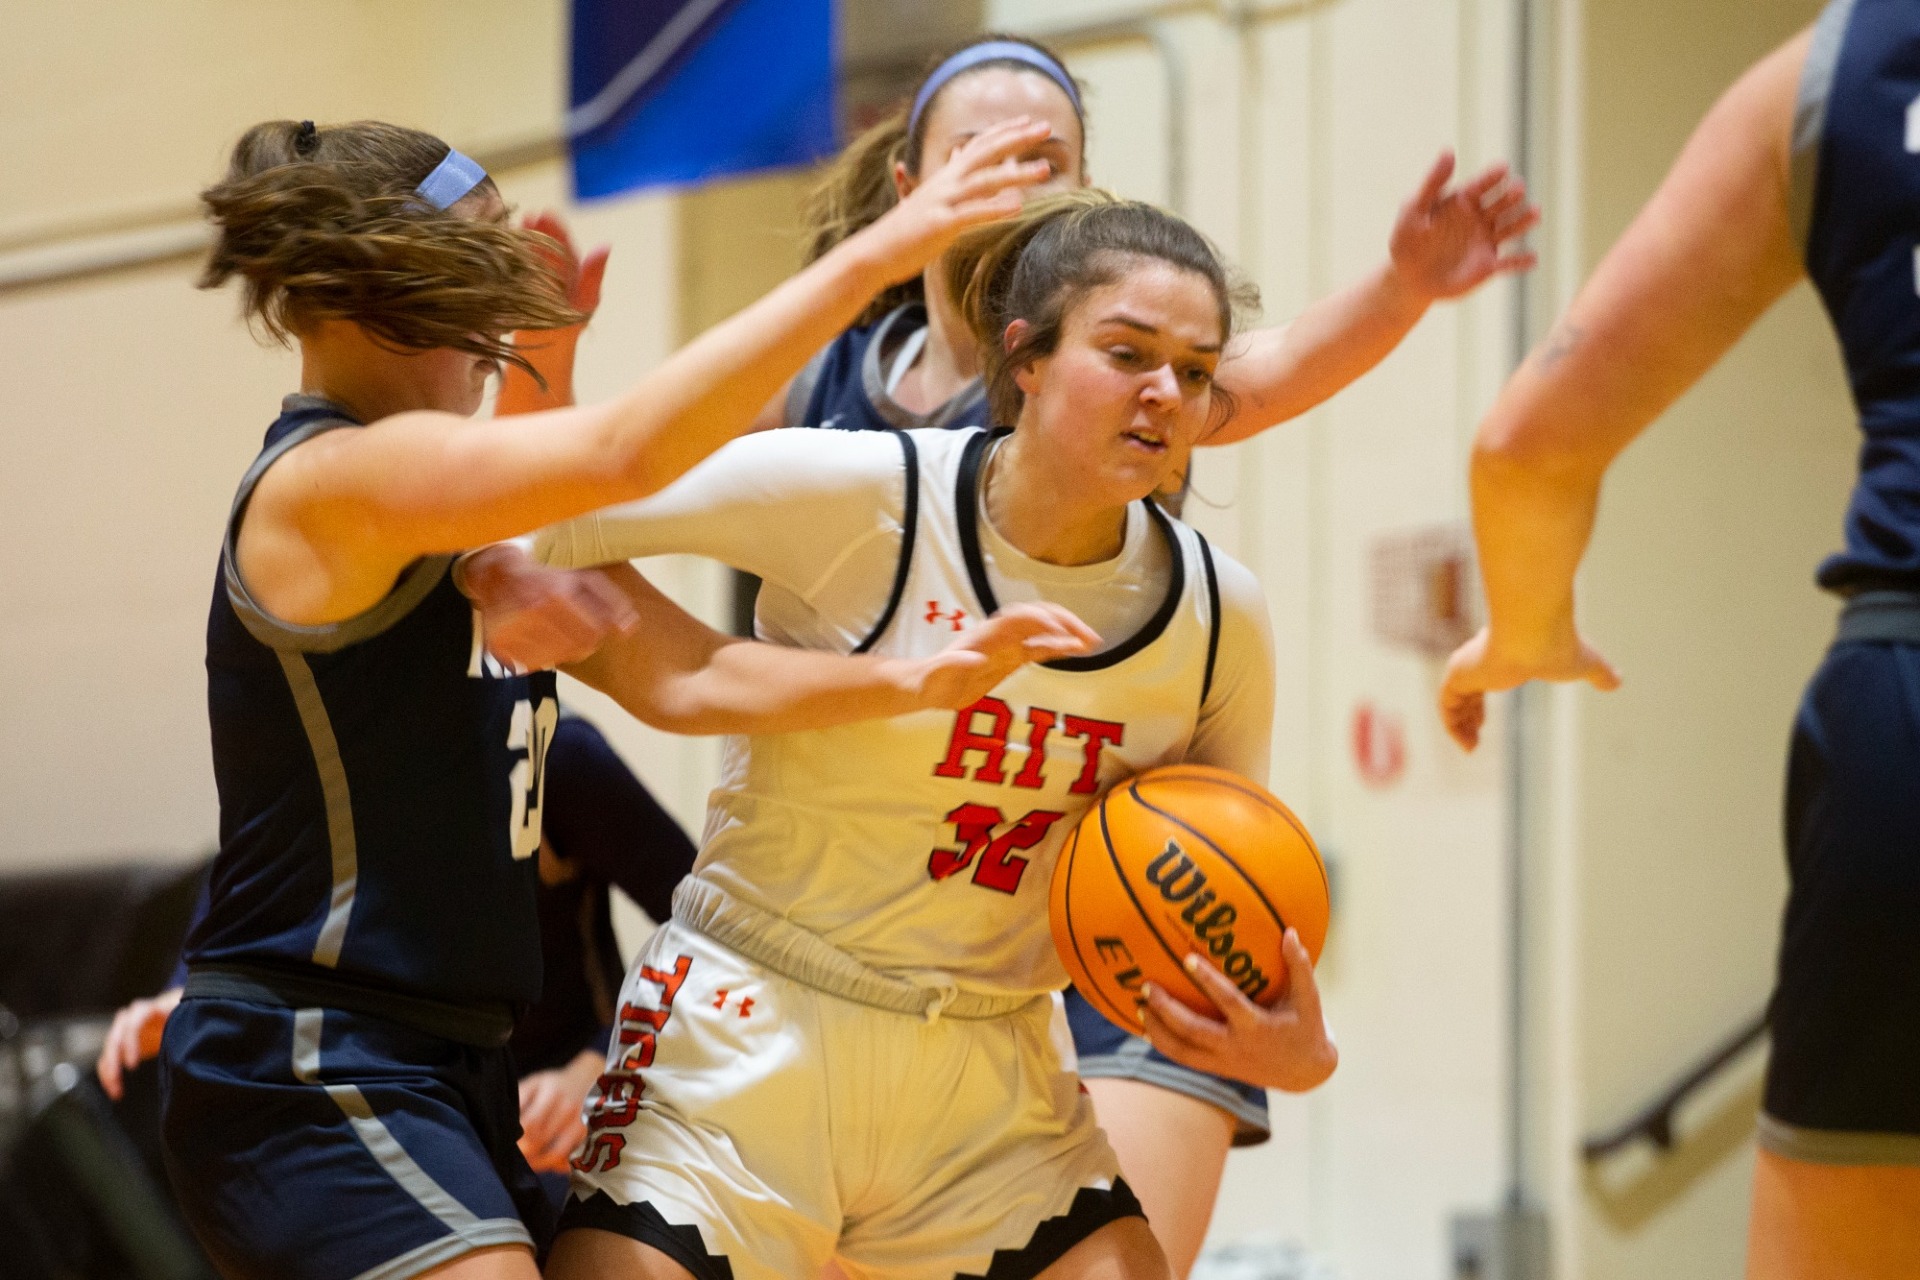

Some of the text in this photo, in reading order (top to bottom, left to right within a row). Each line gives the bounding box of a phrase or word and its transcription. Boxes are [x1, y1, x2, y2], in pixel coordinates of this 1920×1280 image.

[927, 802, 1067, 896] 32
[1145, 836, 1270, 1002] Wilson
[1093, 934, 1150, 1007] EV
